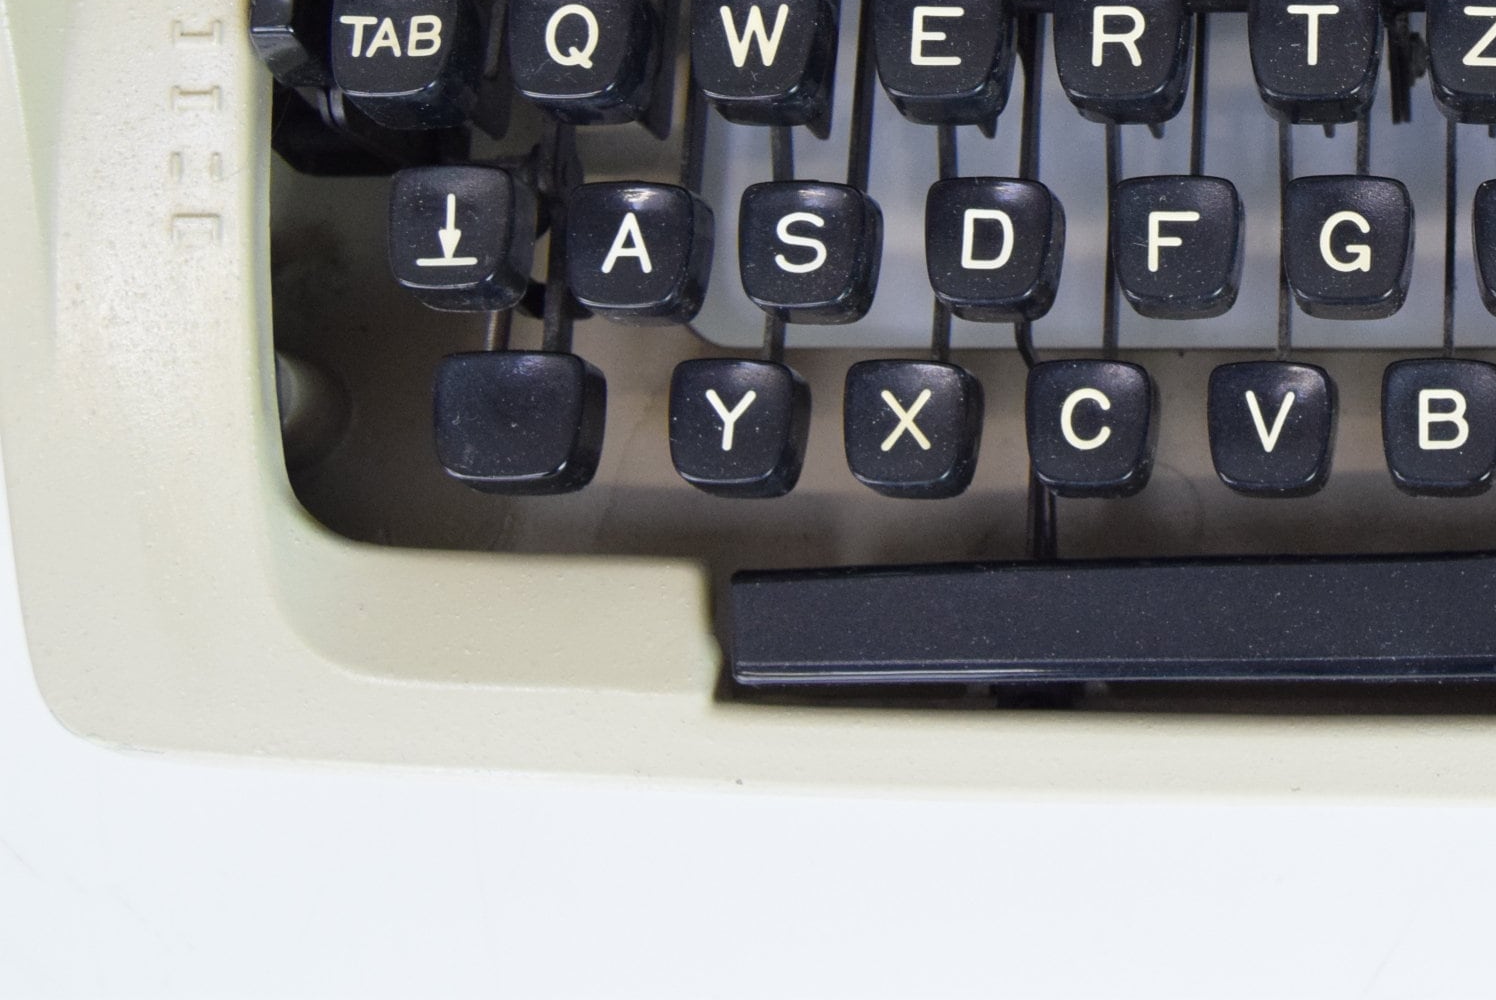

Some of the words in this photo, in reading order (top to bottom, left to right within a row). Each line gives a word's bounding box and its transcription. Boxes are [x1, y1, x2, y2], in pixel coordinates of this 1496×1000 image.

[339, 14, 443, 58] TAB
[547, 3, 600, 69] Q
[721, 3, 789, 68] W
[910, 5, 966, 66] E
[1092, 5, 1147, 67] R
[1286, 3, 1341, 67] T
[601, 211, 654, 273] A
[773, 211, 828, 273] S
[963, 209, 1015, 270] D
[1148, 210, 1201, 271] F
[1319, 210, 1373, 272] G
[707, 388, 758, 451] Y
[880, 388, 933, 451] X
[1061, 387, 1112, 451] C
[1247, 390, 1294, 451] V
[1419, 387, 1471, 451] B
